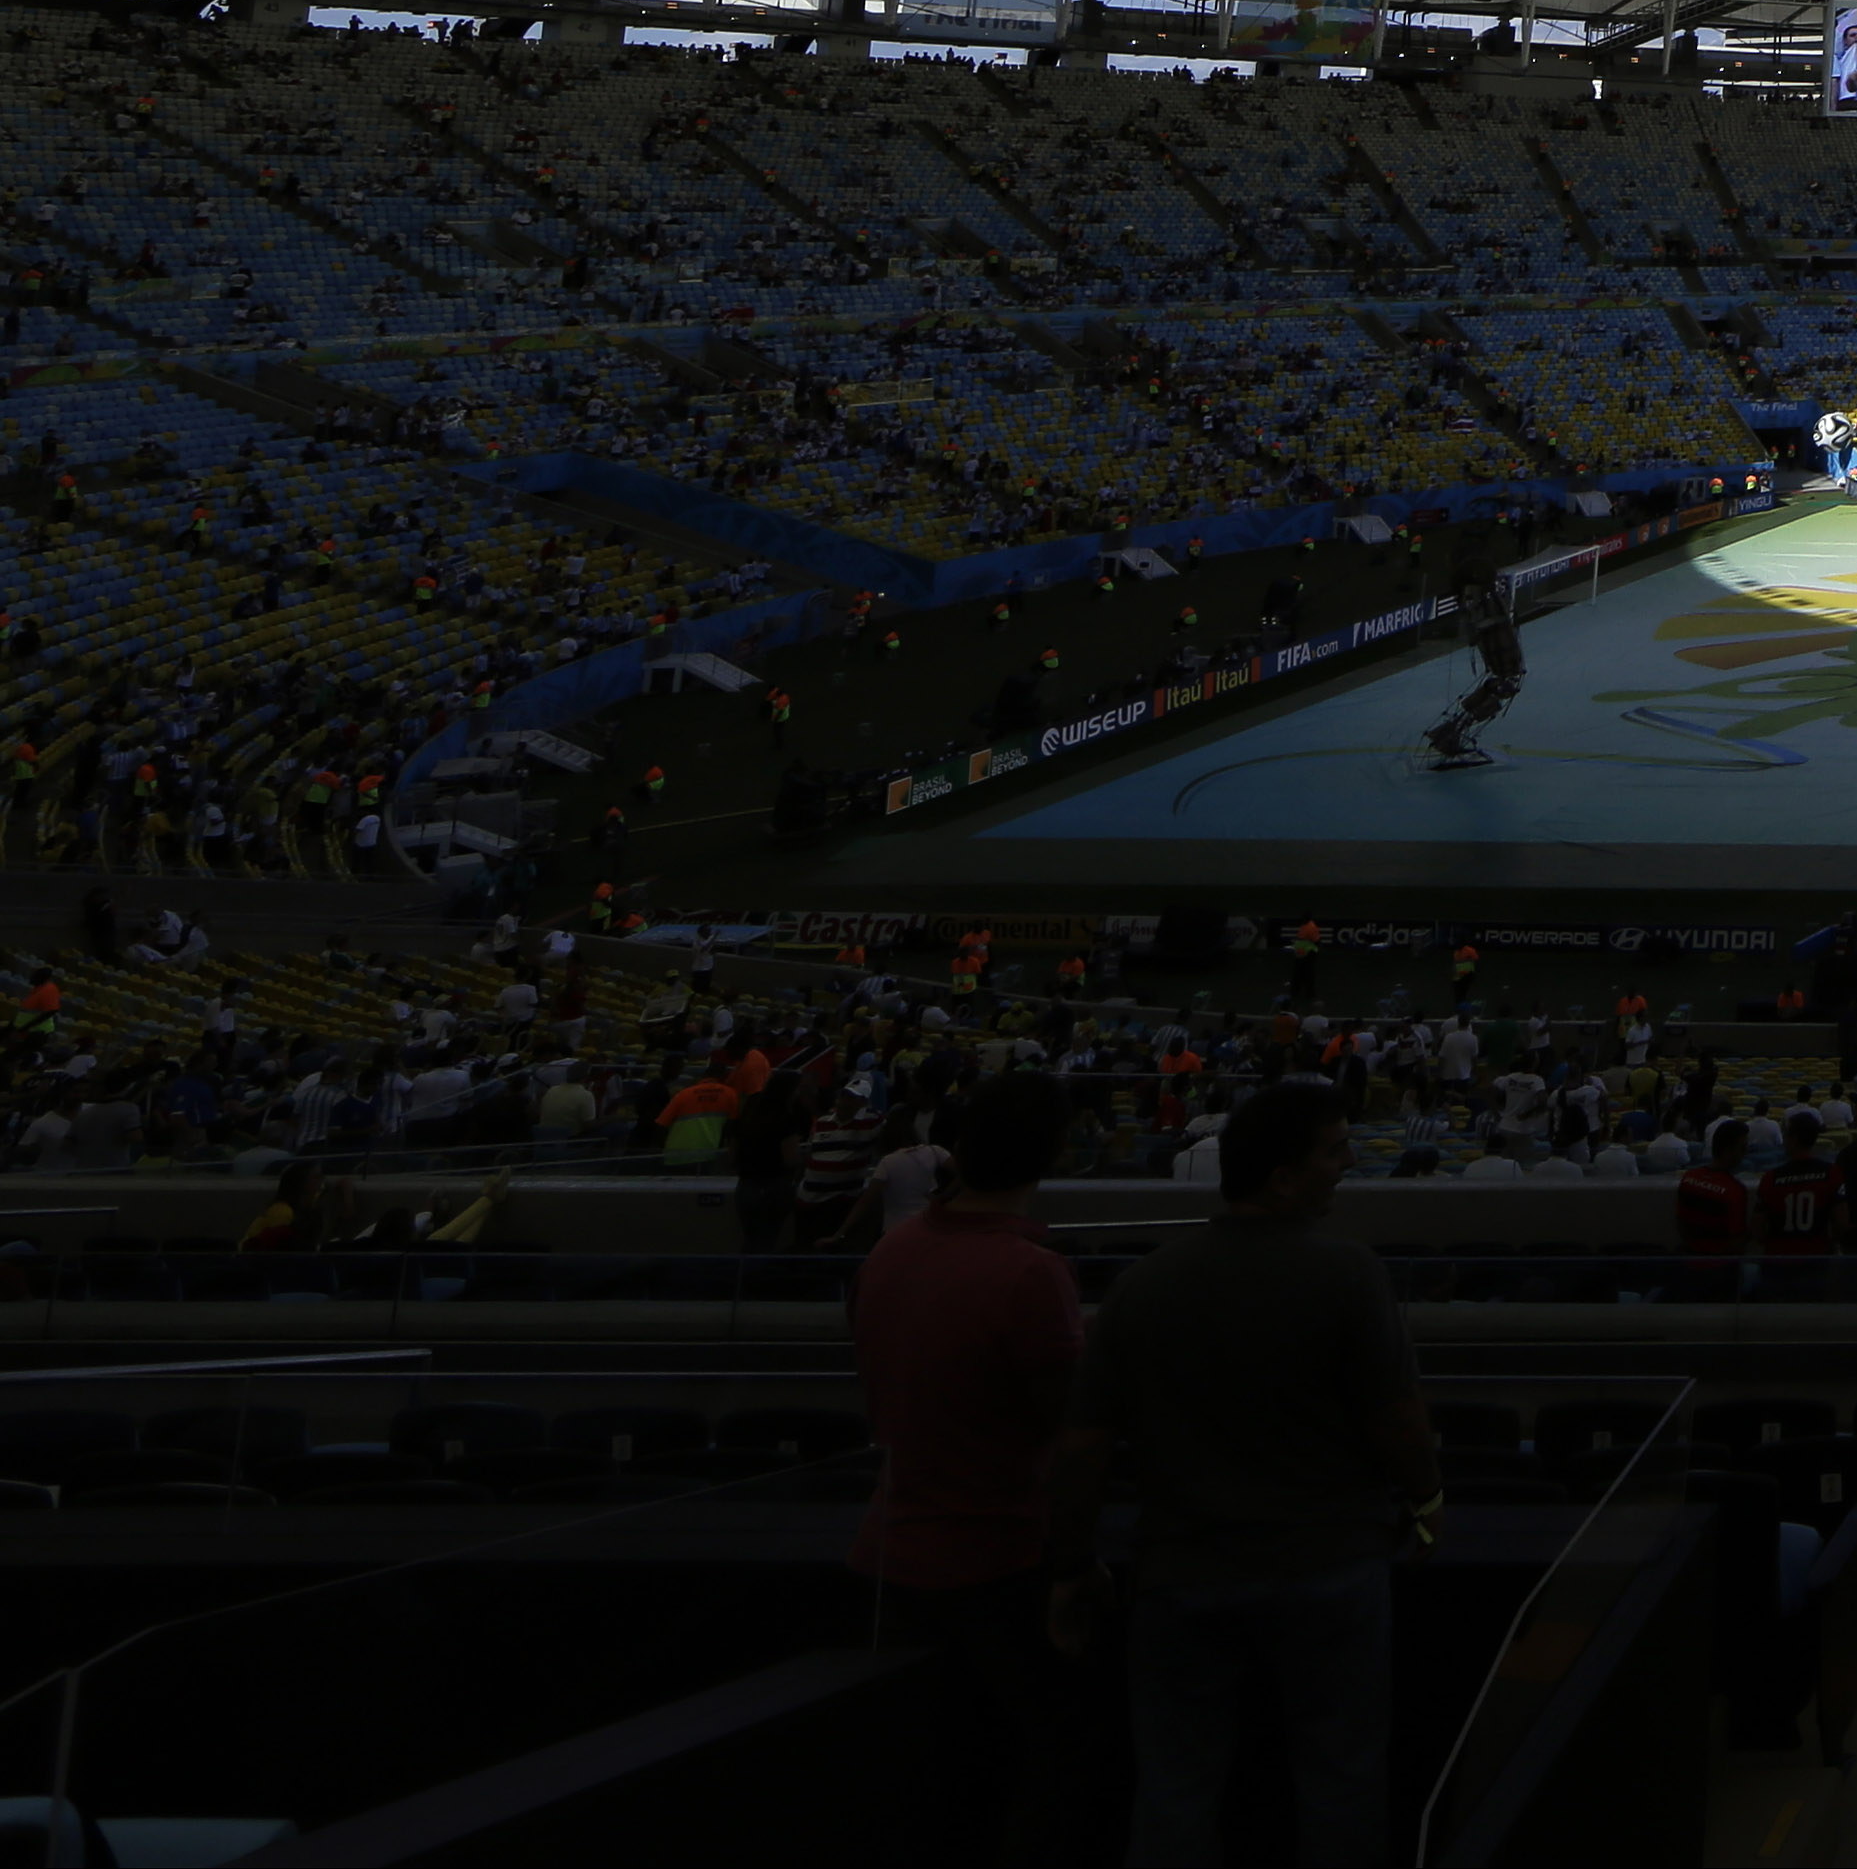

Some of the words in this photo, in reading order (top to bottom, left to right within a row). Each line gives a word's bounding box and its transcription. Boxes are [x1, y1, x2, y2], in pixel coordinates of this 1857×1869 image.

[1752, 402, 1771, 412] The
[1773, 401, 1798, 412] Final
[1364, 603, 1424, 641] MARFRIG
[1216, 662, 1249, 693] Itaú
[1167, 679, 1201, 711] Itaú
[991, 755, 1028, 777] BEYOND
[992, 747, 1024, 766] BRASIL
[912, 782, 953, 805] BEYOND
[913, 774, 947, 794] BRASIL
[801, 912, 919, 943] Castrol
[1485, 929, 1600, 945] POWERADE
[1784, 1190, 1816, 1232] 10
